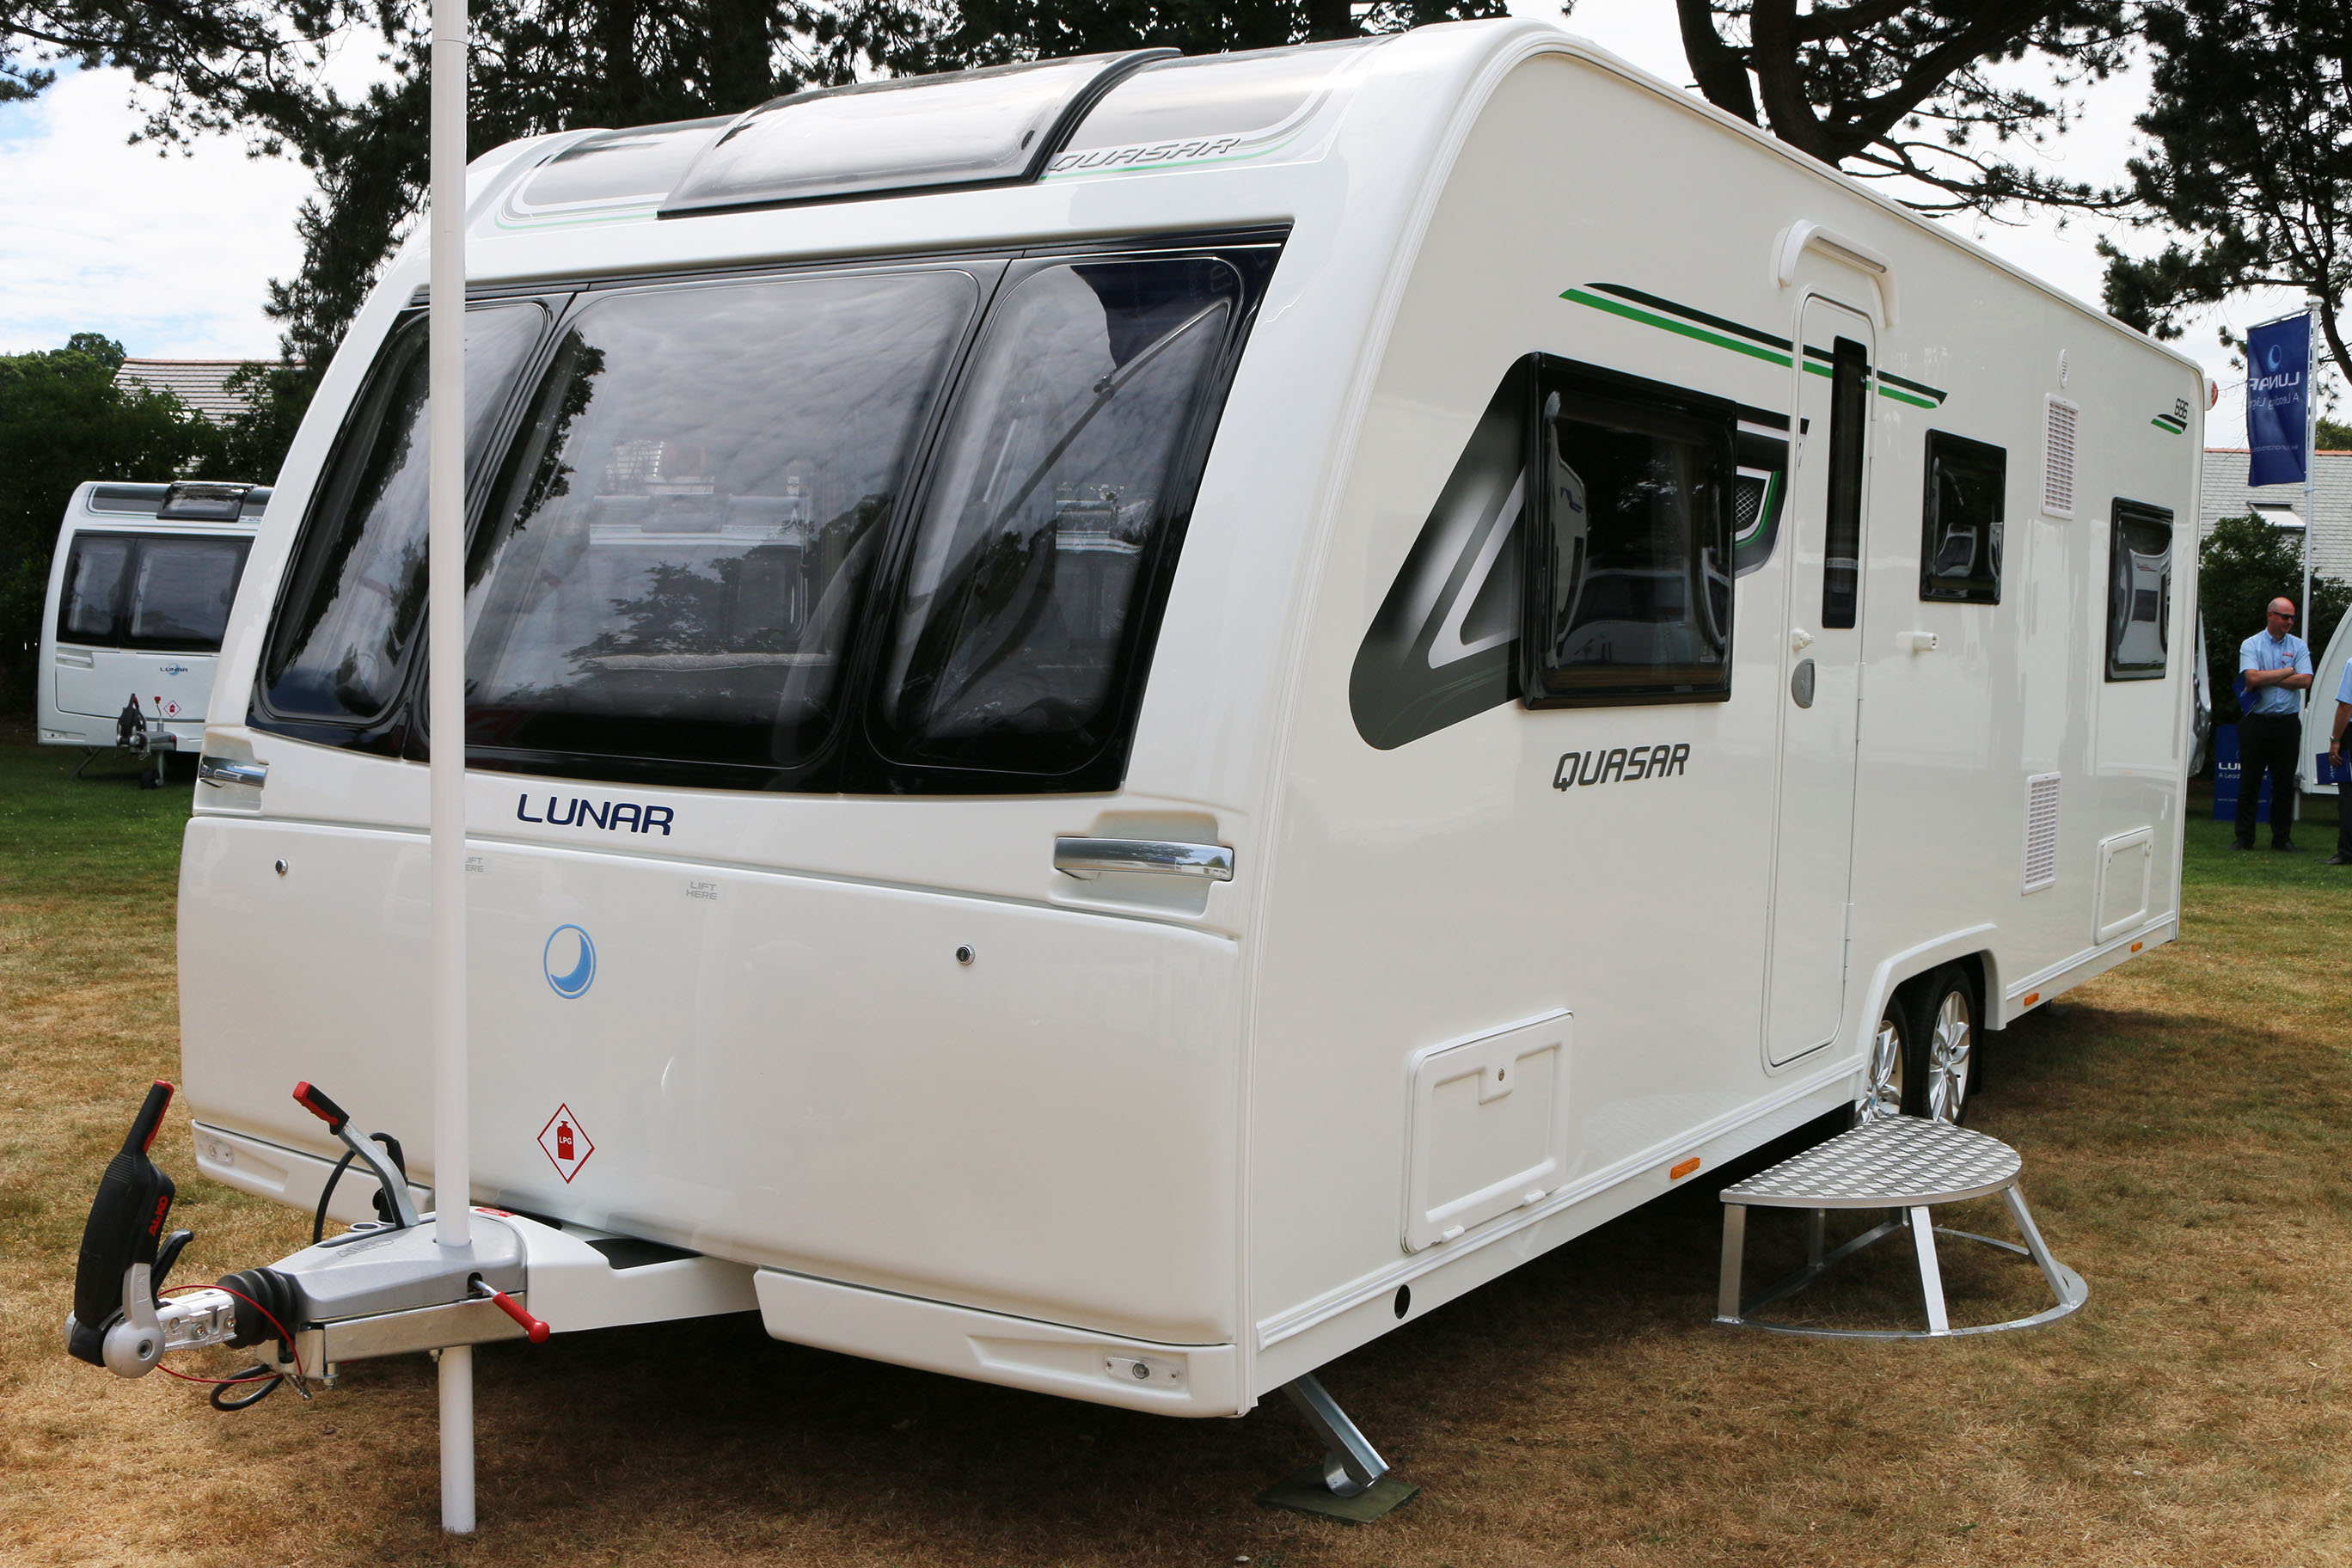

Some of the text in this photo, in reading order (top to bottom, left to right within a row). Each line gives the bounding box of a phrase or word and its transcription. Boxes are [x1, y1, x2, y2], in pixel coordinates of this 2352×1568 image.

[1048, 138, 1240, 172] QUASAR
[1553, 743, 1691, 793] QUASAR
[517, 793, 674, 836] LUNAR
[465, 864, 484, 873] ERE
[690, 881, 717, 891] LIFT
[686, 889, 718, 900] HERE
[559, 1136, 573, 1145] LPG
